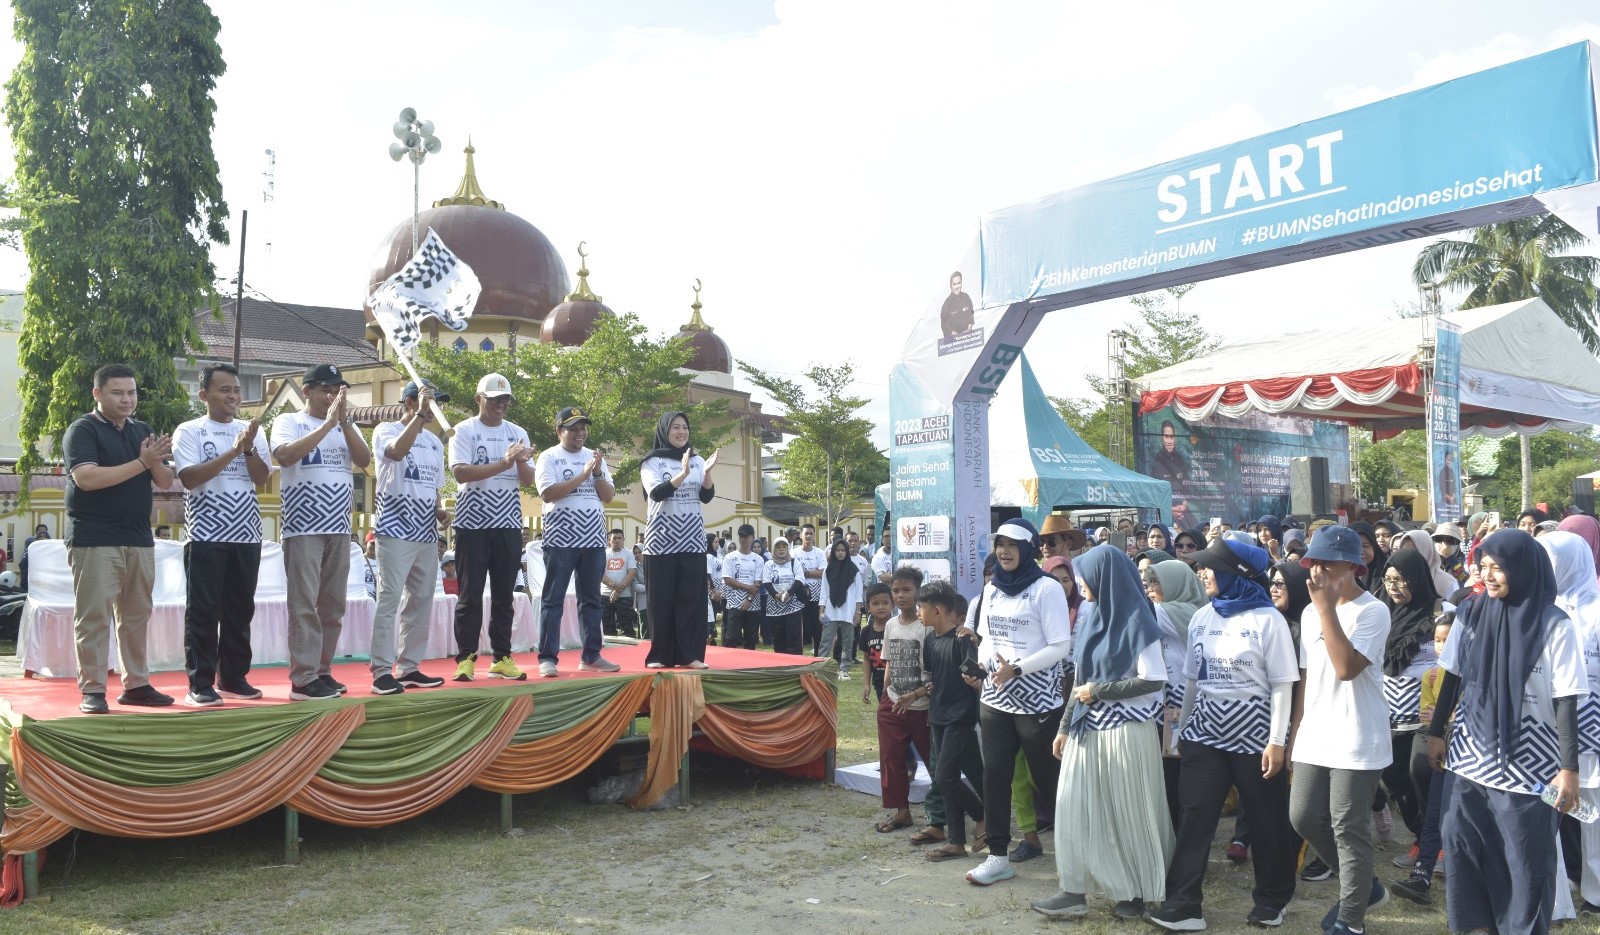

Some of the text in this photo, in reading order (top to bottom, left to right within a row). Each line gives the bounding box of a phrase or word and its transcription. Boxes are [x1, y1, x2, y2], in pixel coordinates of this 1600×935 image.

[1157, 129, 1343, 223] START
[1241, 163, 1543, 246] #BUMNSehatIndonesiaSehat
[971, 343, 1022, 394] BSI
[895, 415, 948, 434] 2023 ACEH
[896, 429, 948, 445] TAPAKTUAN
[963, 400, 973, 467] INDONESIA
[972, 401, 982, 488] BANK SYARIAH
[1032, 447, 1067, 464] BSI
[1272, 455, 1283, 465] FEB
[895, 460, 950, 475] Jalan Sehat
[896, 476, 936, 488] Bersama
[896, 489, 923, 501] BUMN
[1087, 485, 1107, 501] BSI
[967, 515, 977, 584] JASA RAHARJA
[990, 614, 1030, 626] Jalan Sehat
[990, 622, 1018, 632] Bersama
[990, 629, 1009, 638] BUMN
[1208, 656, 1254, 668] Jalan Sehat
[1208, 664, 1243, 673] Bersama
[1209, 673, 1232, 681] BUMN
